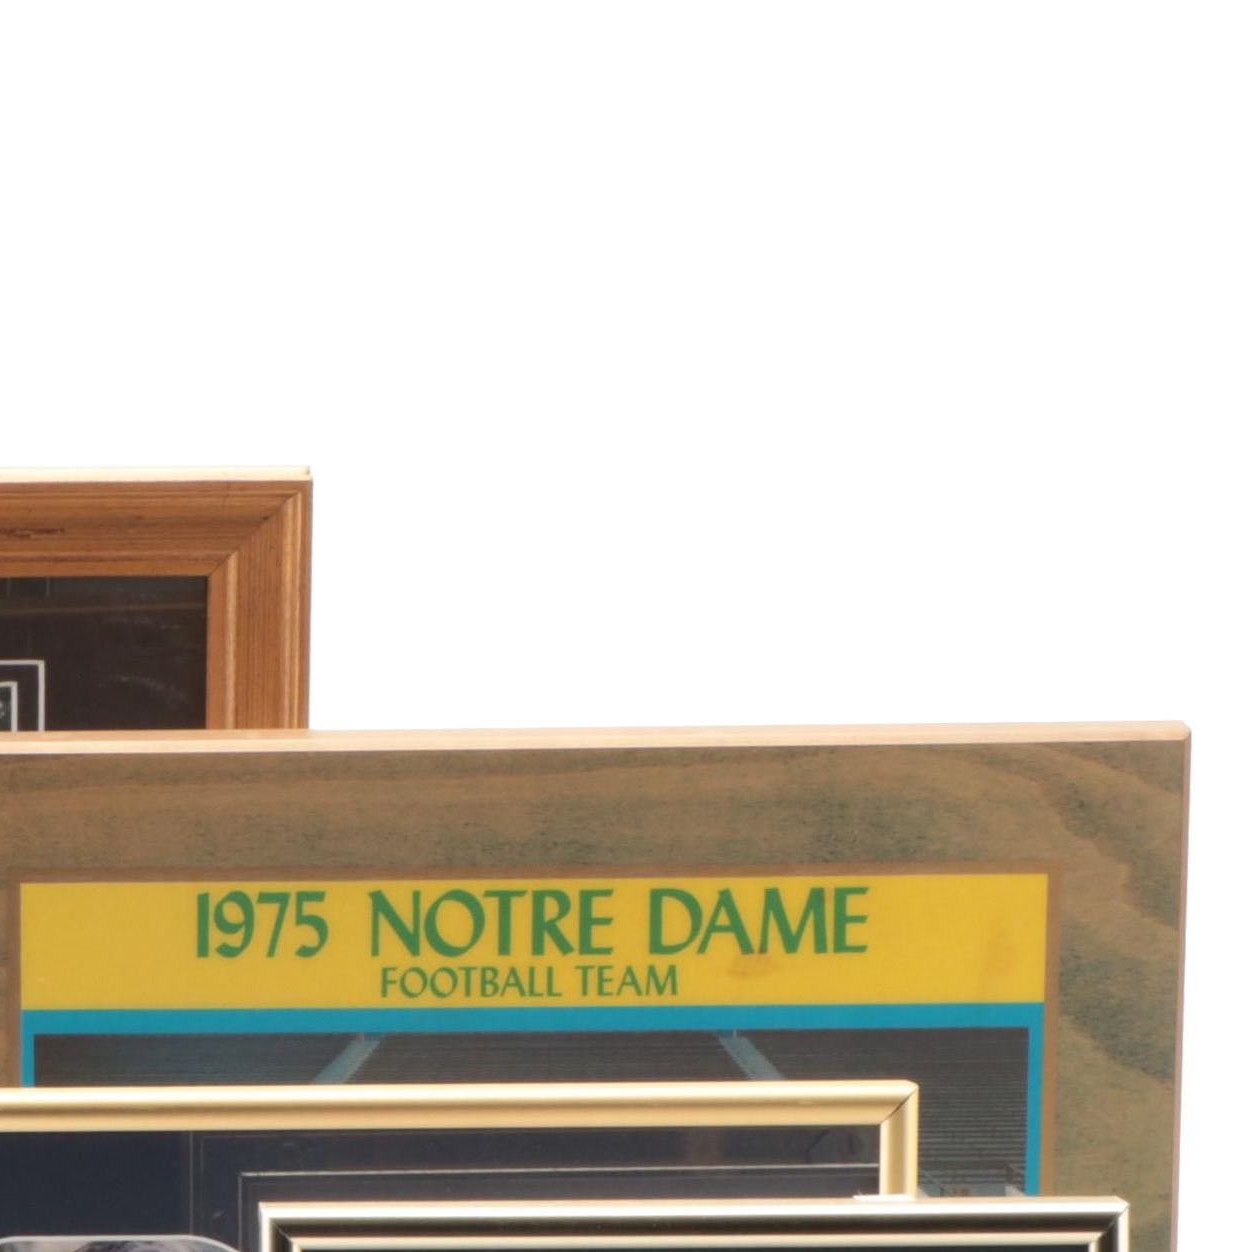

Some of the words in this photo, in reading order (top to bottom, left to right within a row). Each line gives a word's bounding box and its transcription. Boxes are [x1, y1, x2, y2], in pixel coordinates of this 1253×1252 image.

[196, 890, 329, 958] 1975
[368, 888, 615, 958] NOTRE
[649, 886, 870, 955] DAME
[380, 965, 562, 999] FOOTBALL
[574, 964, 679, 998] TEAM
